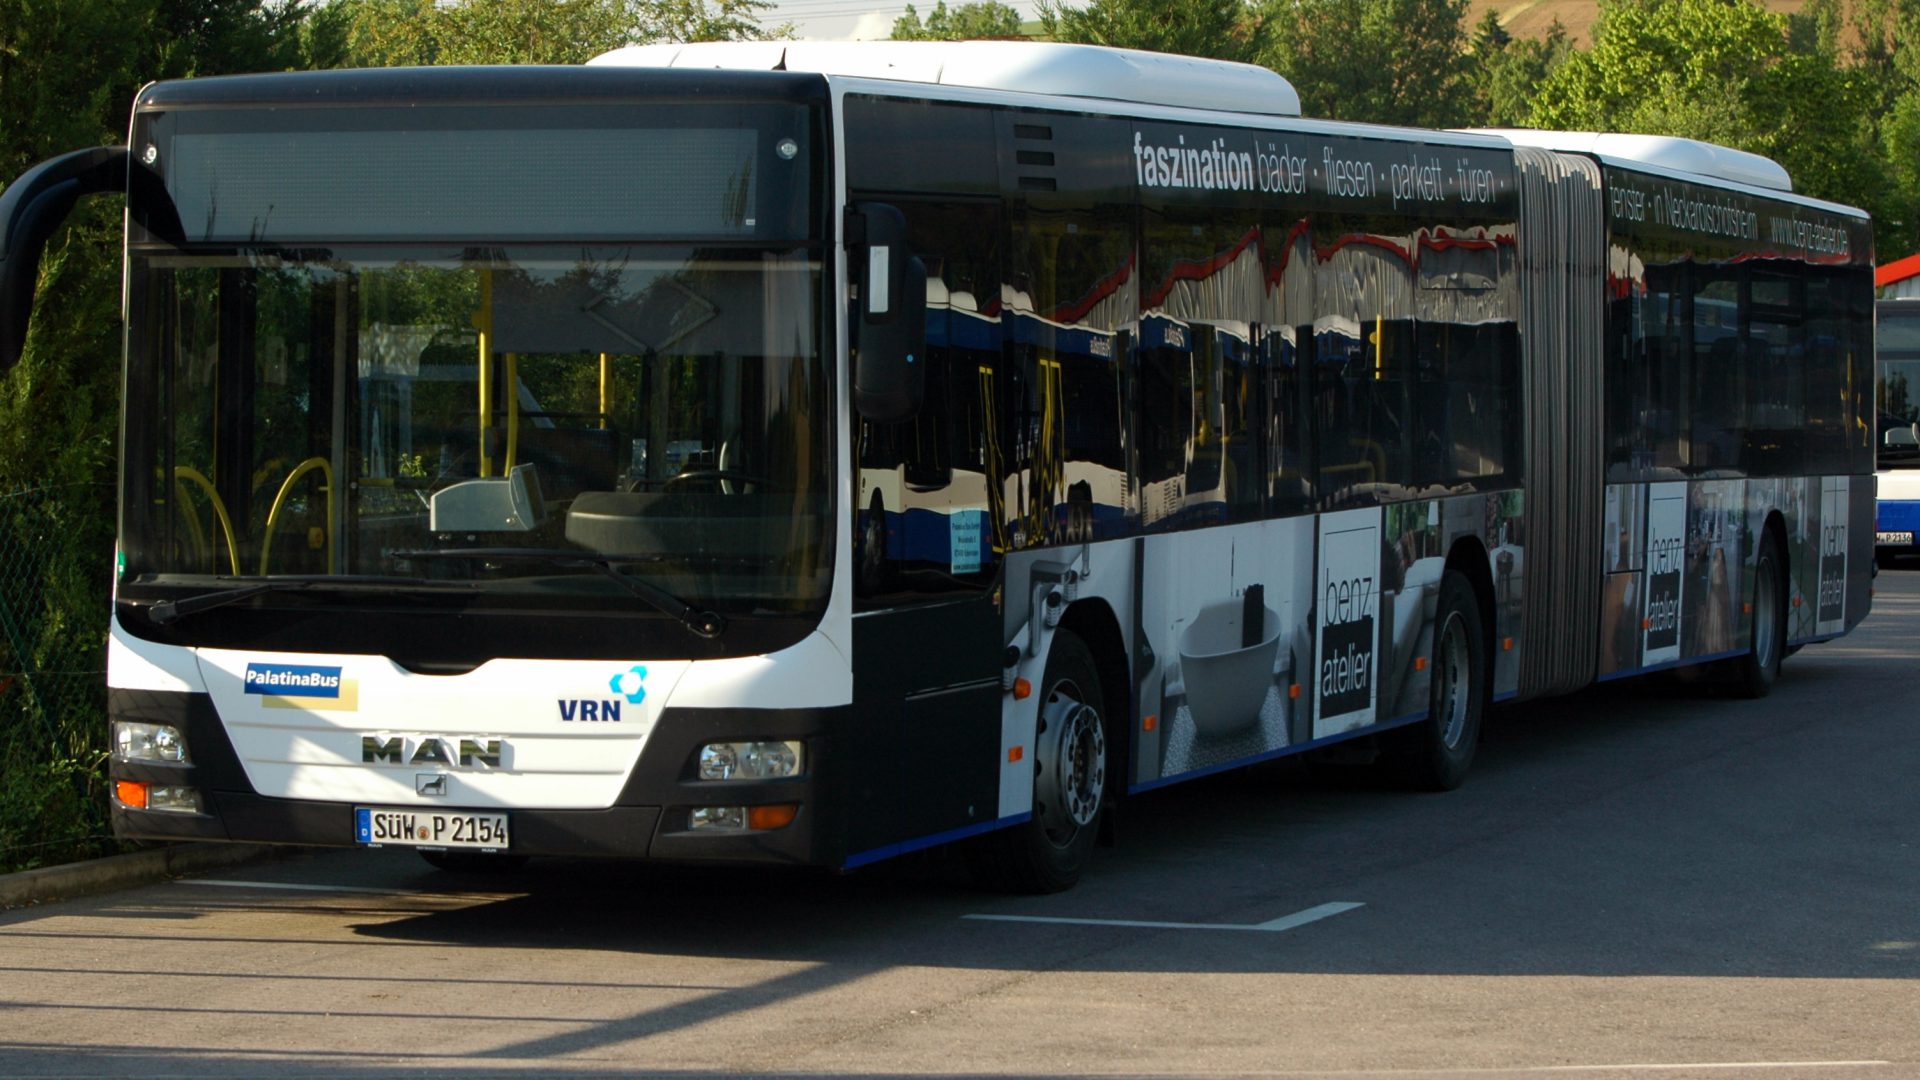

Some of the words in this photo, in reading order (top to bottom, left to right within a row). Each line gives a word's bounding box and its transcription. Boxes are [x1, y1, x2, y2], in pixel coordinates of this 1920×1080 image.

[1134, 131, 1254, 191] faszination
[1255, 140, 1307, 194] bäder
[1323, 146, 1375, 198] fliesen
[1391, 154, 1445, 210] parkett
[1457, 158, 1496, 204] türen
[1610, 176, 1645, 222] fenster
[1653, 184, 1664, 225] in
[1652, 528, 1681, 575] benz
[1824, 515, 1845, 557] benz
[1326, 567, 1372, 626] benz
[1649, 590, 1679, 633] atelier
[246, 669, 339, 689] PalatinaBus
[1322, 643, 1371, 697] atelier
[558, 700, 621, 722] VRN
[362, 736, 502, 768] MAN
[374, 813, 416, 840] SÜW
[433, 816, 446, 841] P
[452, 816, 506, 844] 2154
